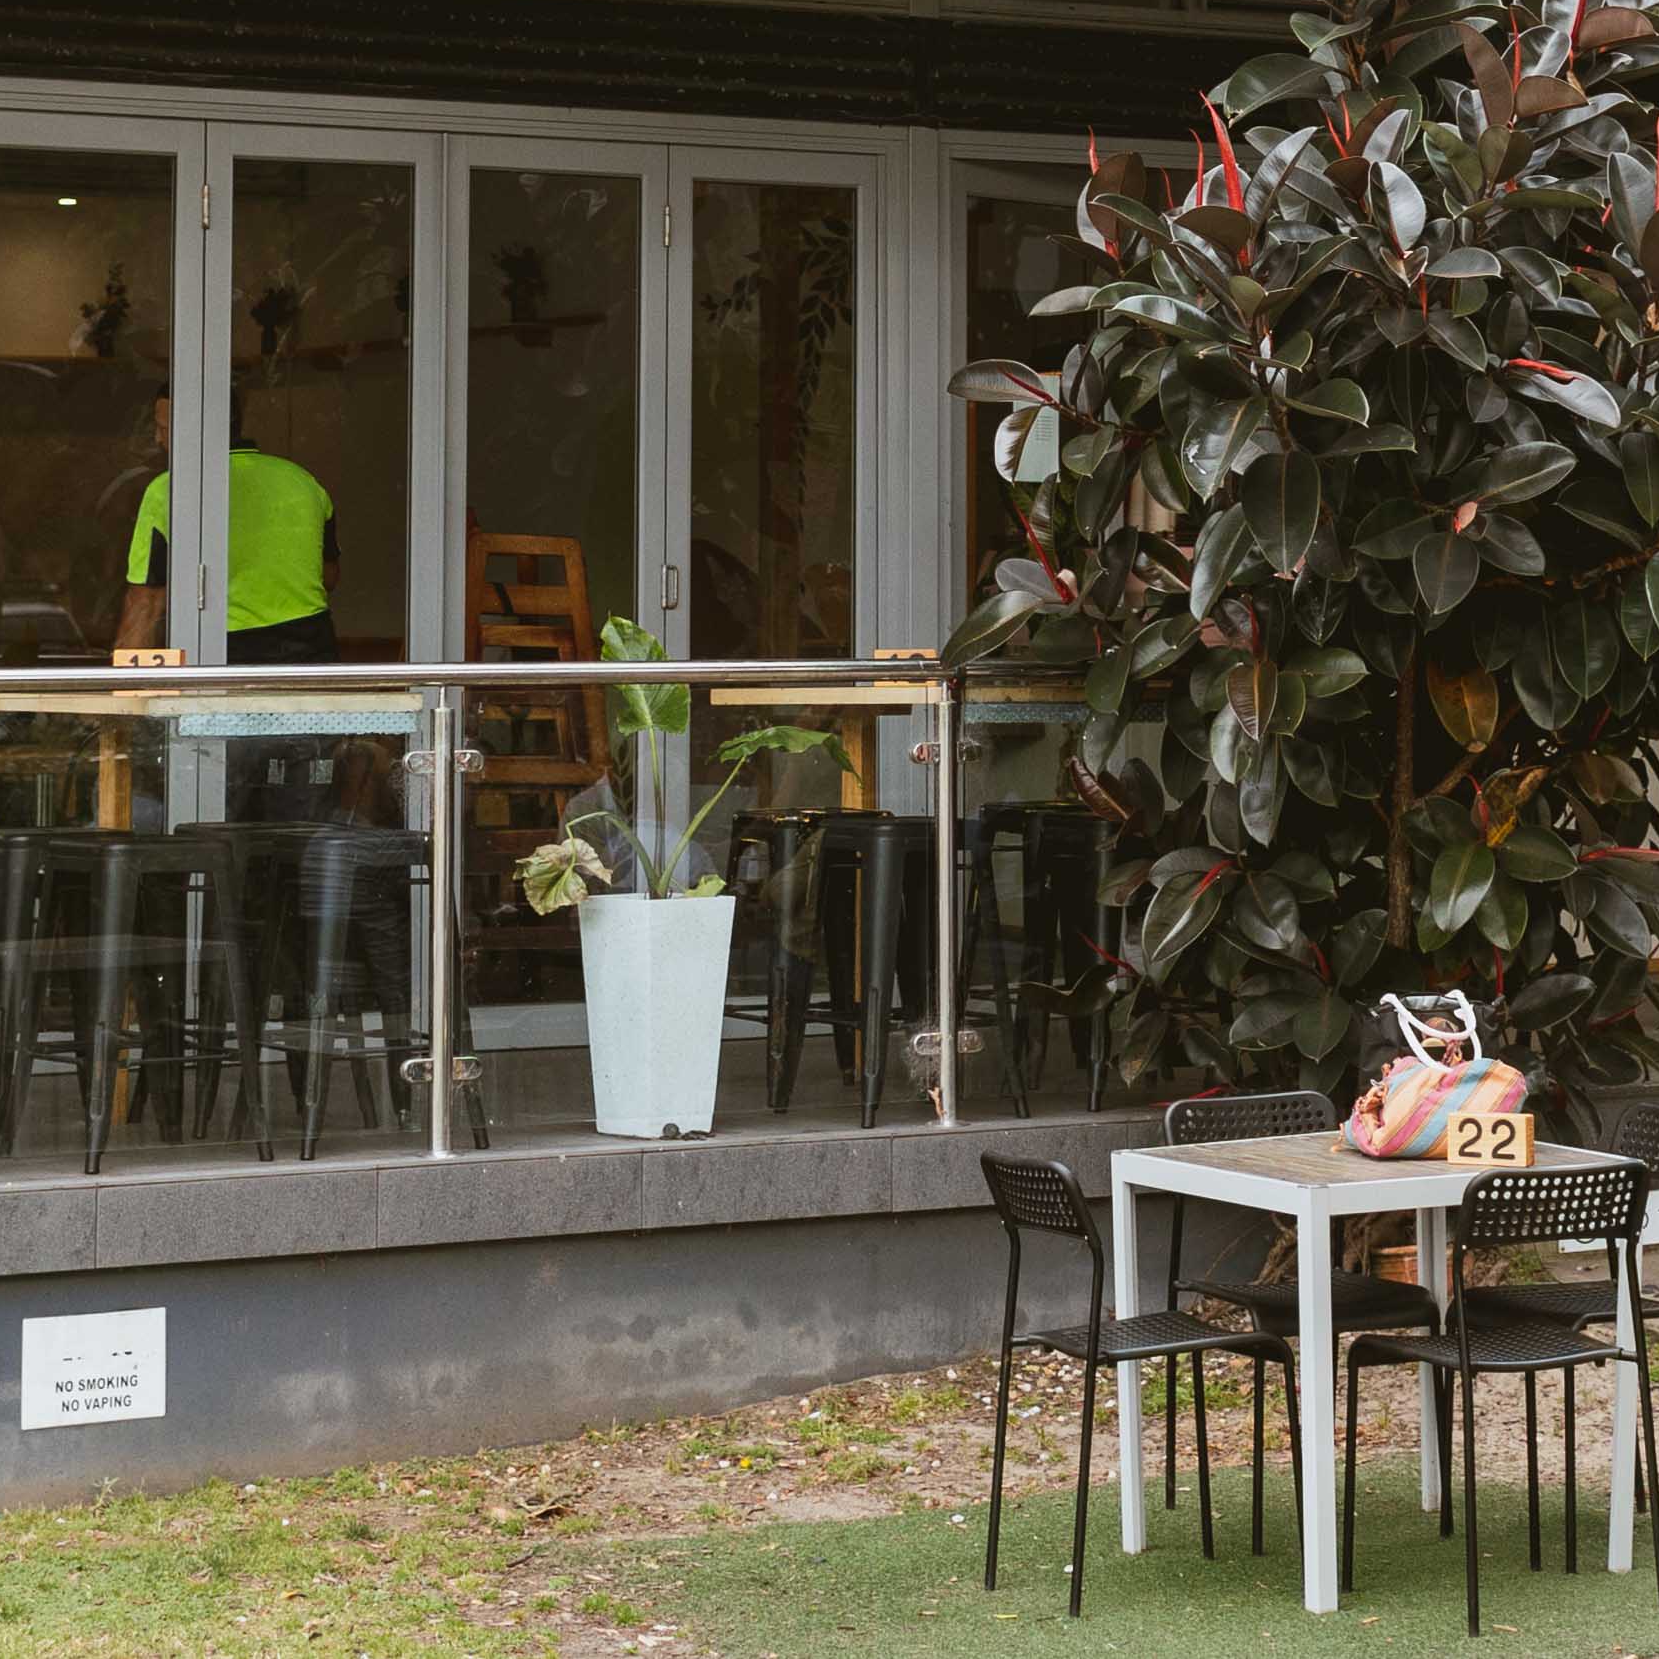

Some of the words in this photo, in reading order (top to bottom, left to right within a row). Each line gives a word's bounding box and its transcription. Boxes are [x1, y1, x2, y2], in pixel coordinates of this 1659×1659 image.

[1458, 1118, 1516, 1160] 22
[55, 1380, 73, 1393] NO
[78, 1374, 138, 1391] SMOKING
[61, 1399, 79, 1412] NO
[84, 1394, 132, 1410] VAPING
